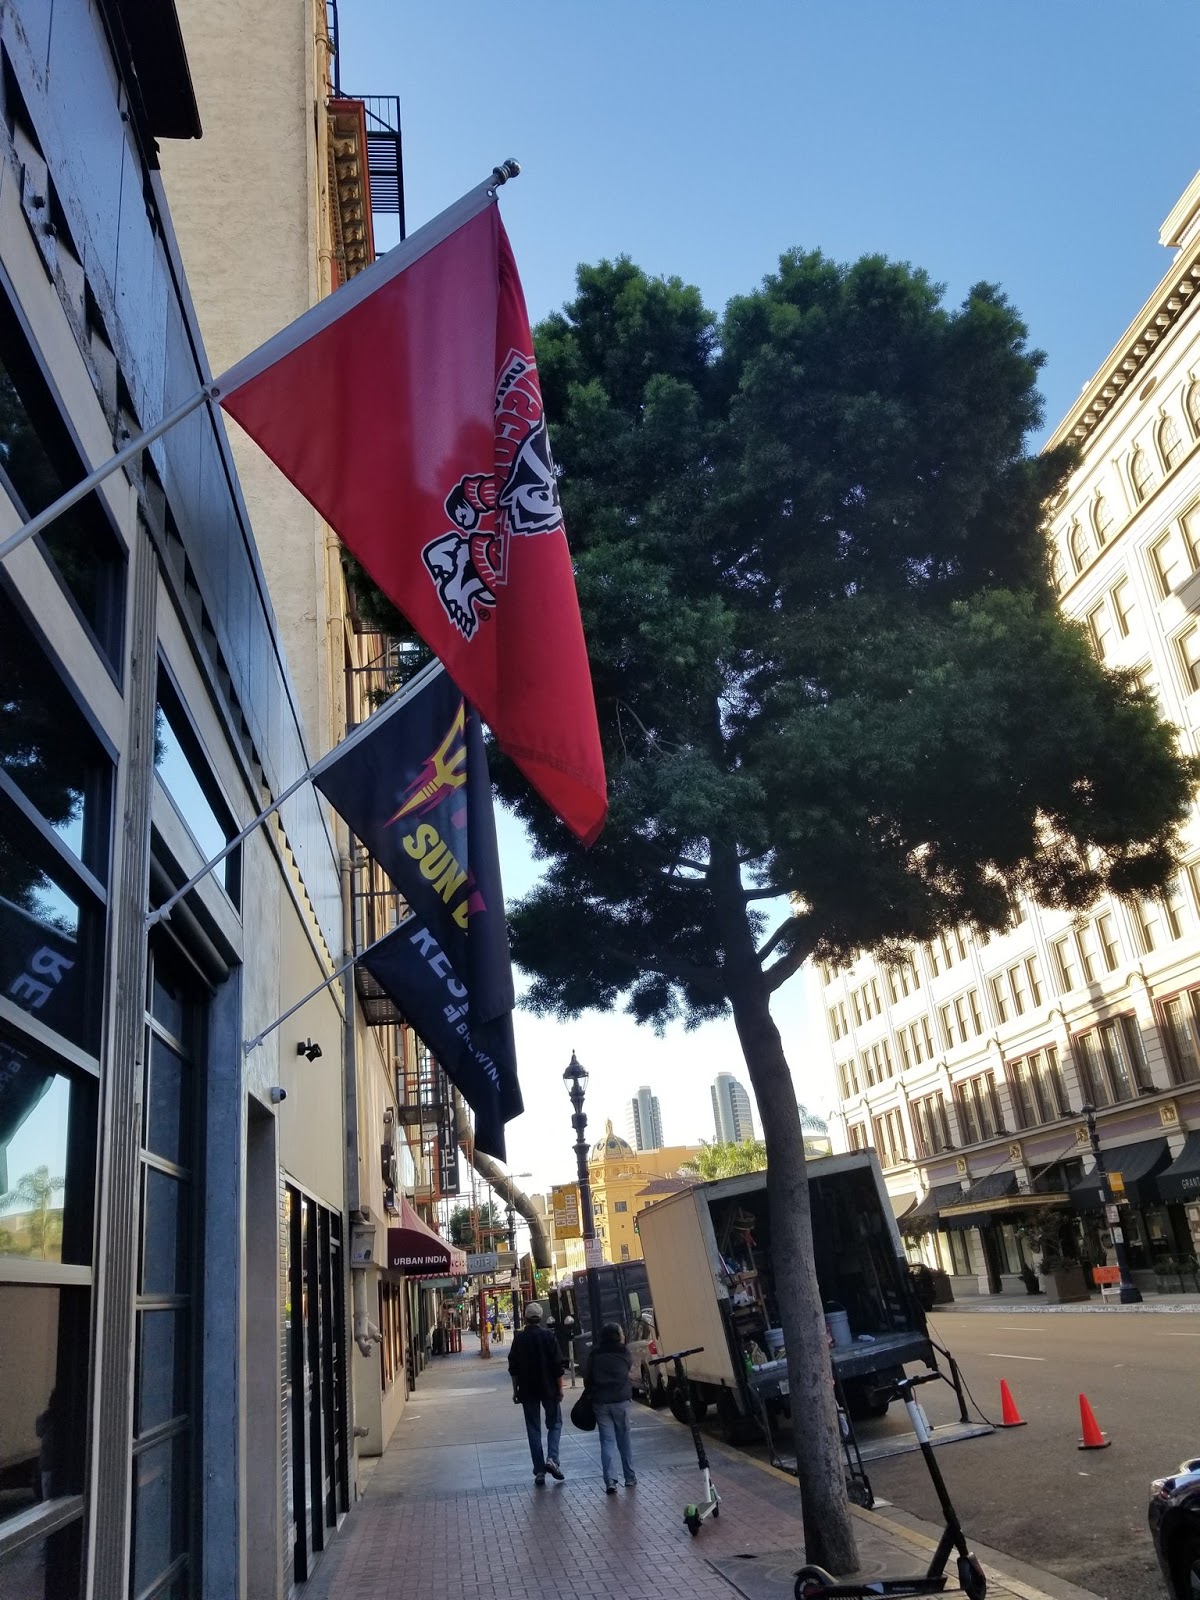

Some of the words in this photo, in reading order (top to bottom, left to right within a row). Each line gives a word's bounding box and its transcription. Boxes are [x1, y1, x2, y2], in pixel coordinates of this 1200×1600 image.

[402, 823, 468, 904] SUN
[456, 1022, 501, 1091] BRWIN
[555, 1208, 567, 1226] CITY
[565, 1194, 578, 1226] CENTER
[393, 1256, 424, 1266] URBAN
[425, 1255, 448, 1264] INDIA
